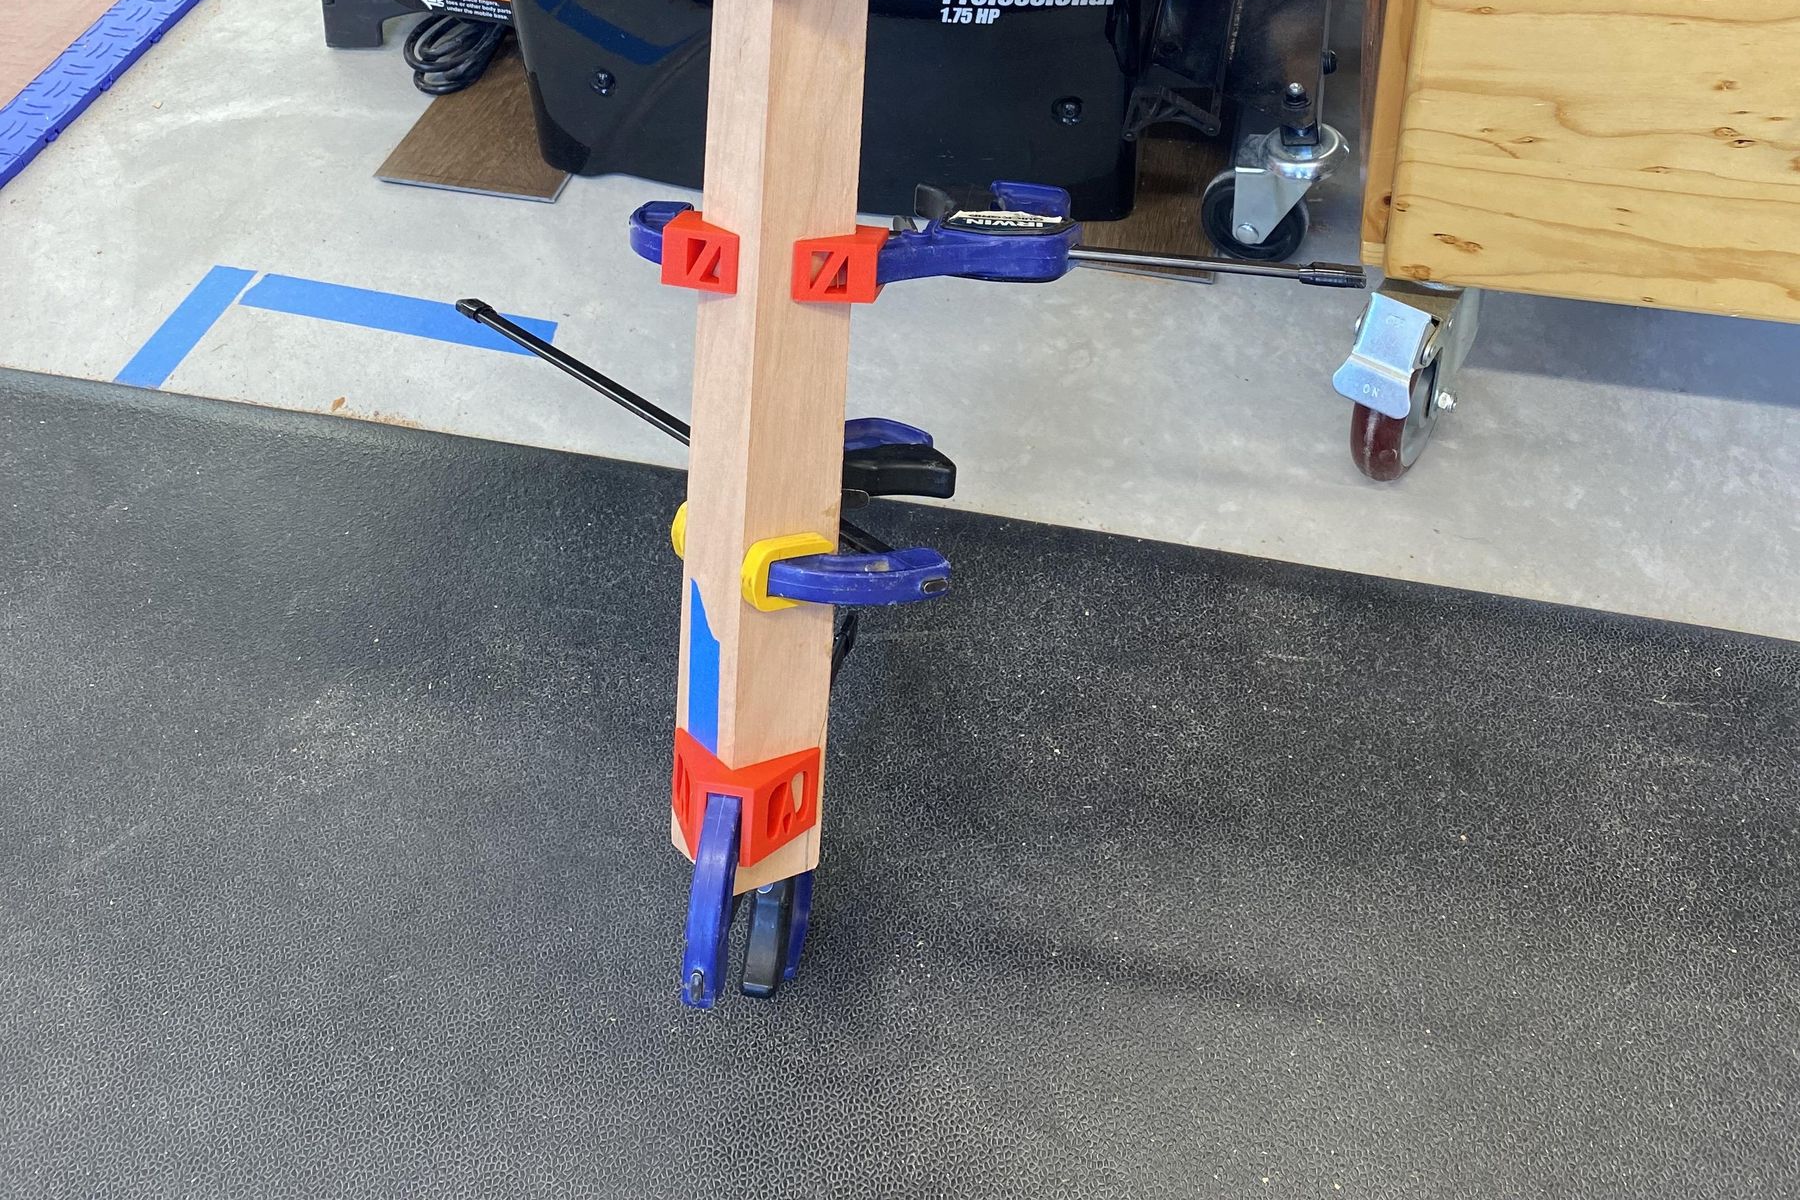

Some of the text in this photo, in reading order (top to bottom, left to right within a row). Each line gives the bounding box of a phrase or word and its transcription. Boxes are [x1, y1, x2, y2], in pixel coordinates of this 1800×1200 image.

[474, 10, 493, 18] mobile
[481, 5, 496, 13] body
[940, 8, 1000, 25] 1.75 HP
[965, 218, 1044, 228] IRWIN
[1362, 383, 1380, 398] ON
